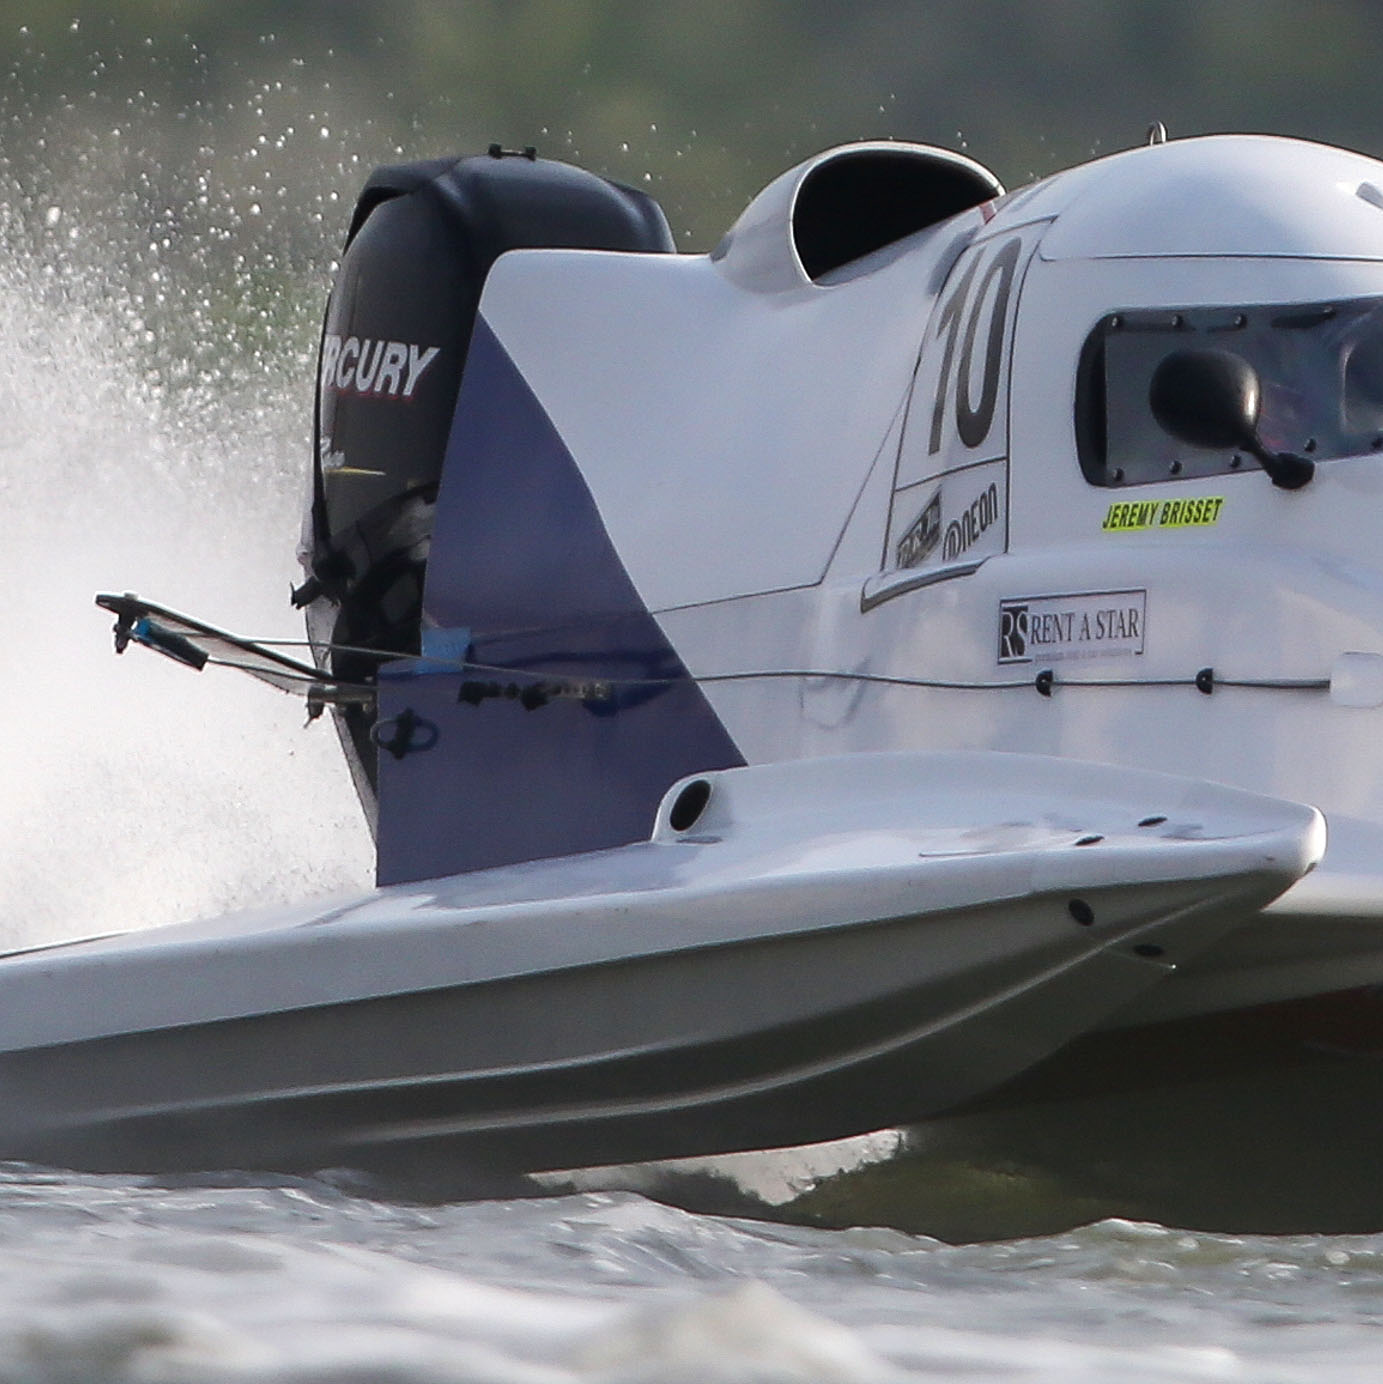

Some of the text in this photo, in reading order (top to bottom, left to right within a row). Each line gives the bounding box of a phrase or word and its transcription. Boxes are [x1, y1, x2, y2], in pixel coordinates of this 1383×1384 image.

[928, 236, 1022, 456] 10
[1102, 498, 1223, 529] JEREMY BRISSET
[1030, 607, 1140, 645] RENT A STAR
